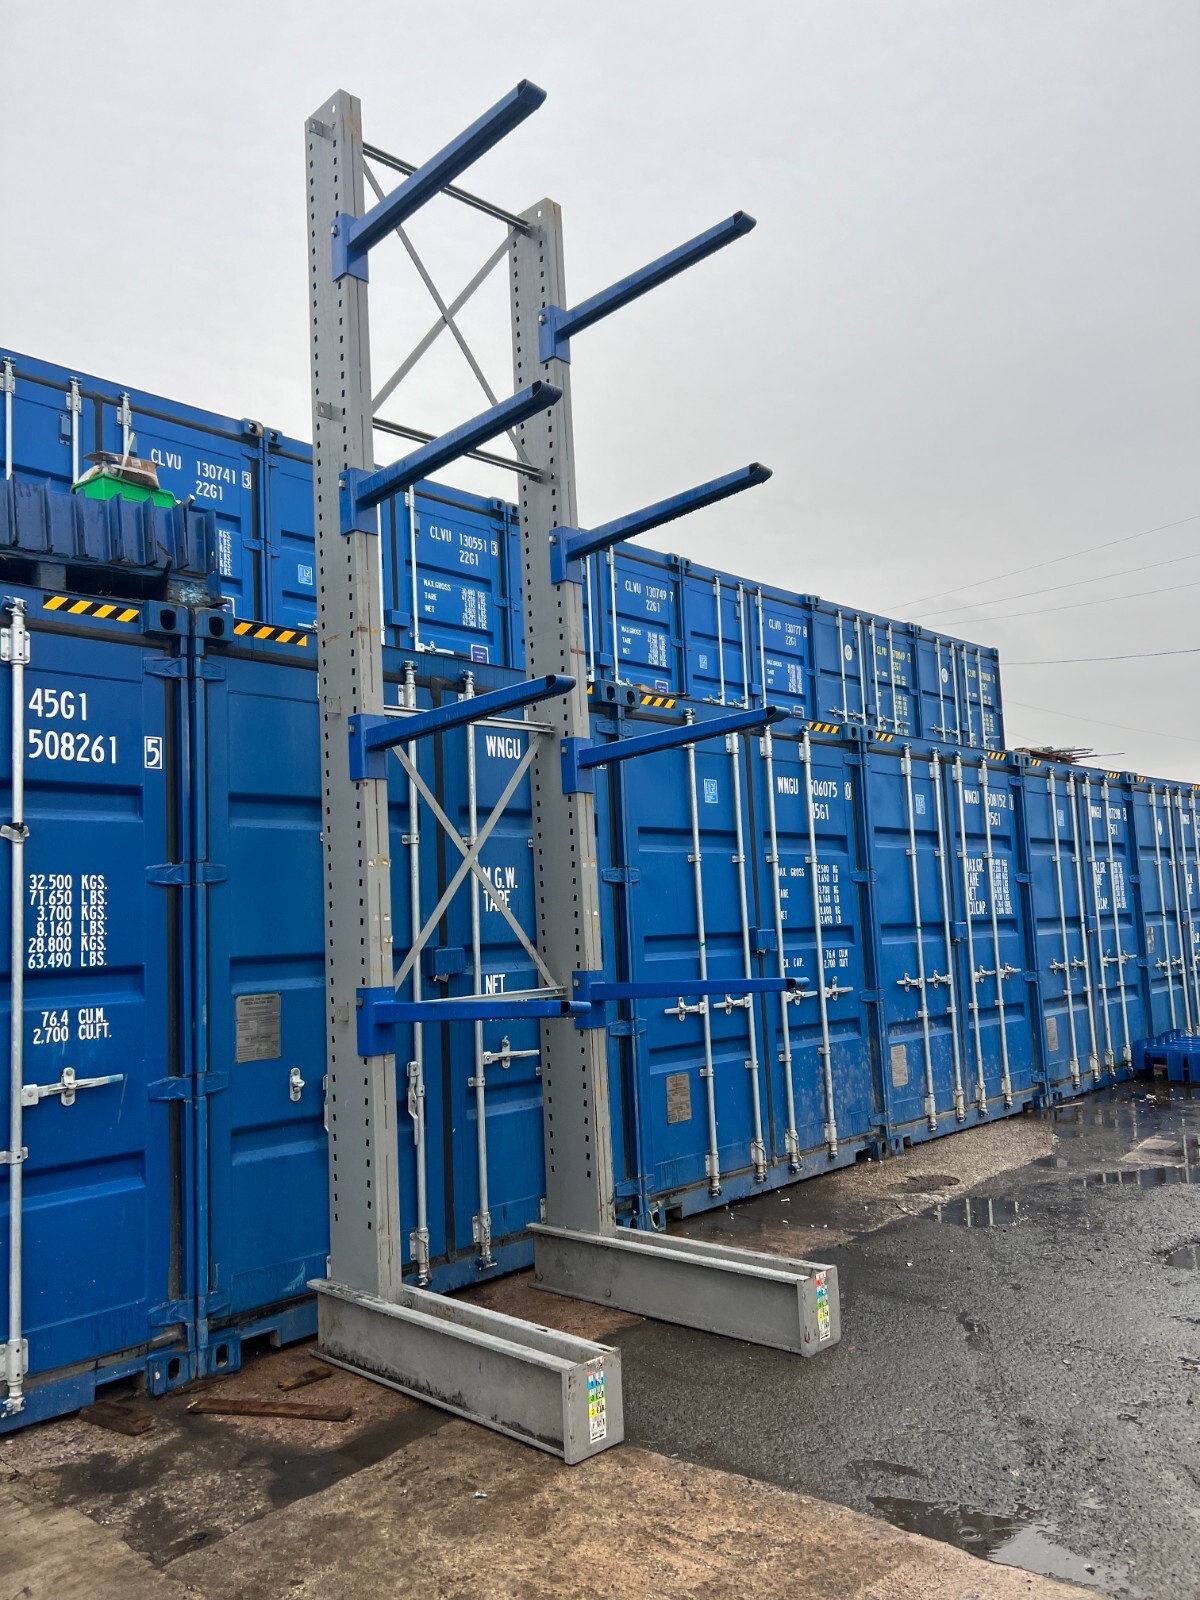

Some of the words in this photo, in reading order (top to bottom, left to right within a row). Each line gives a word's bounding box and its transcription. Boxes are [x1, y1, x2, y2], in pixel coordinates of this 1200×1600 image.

[150, 448, 182, 470] CLVU
[196, 460, 236, 484] 130741
[244, 474, 251, 488] 3
[196, 480, 223, 501] 22G1
[430, 526, 452, 543] CLVU
[460, 533, 487, 552] 130551
[460, 550, 479, 566] 22G1
[424, 591, 438, 601] TARE
[624, 580, 642, 594] CLVU
[646, 586, 667, 600] 130749
[424, 604, 435, 613] NET
[646, 600, 660, 614] 22G1
[28, 688, 88, 721] 45G1
[28, 730, 117, 764] 508261
[146, 738, 161, 768] 5
[485, 735, 522, 760] WNGU
[777, 776, 799, 794] WNGU
[28, 874, 72, 890] 32,500
[81, 874, 108, 890] KGS.
[482, 866, 518, 888] MG.W.
[28, 890, 72, 906] 71,650
[780, 889, 789, 898] ARE
[37, 905, 72, 921] 3,700
[81, 906, 107, 920] KGS.
[36, 921, 72, 938] 8,160
[28, 937, 72, 954] 28,800
[80, 936, 107, 952] KGS.
[28, 952, 72, 969] 63,490
[485, 974, 506, 995] NET
[41, 1010, 69, 1028] 76.4
[32, 1026, 69, 1045] 2,700
